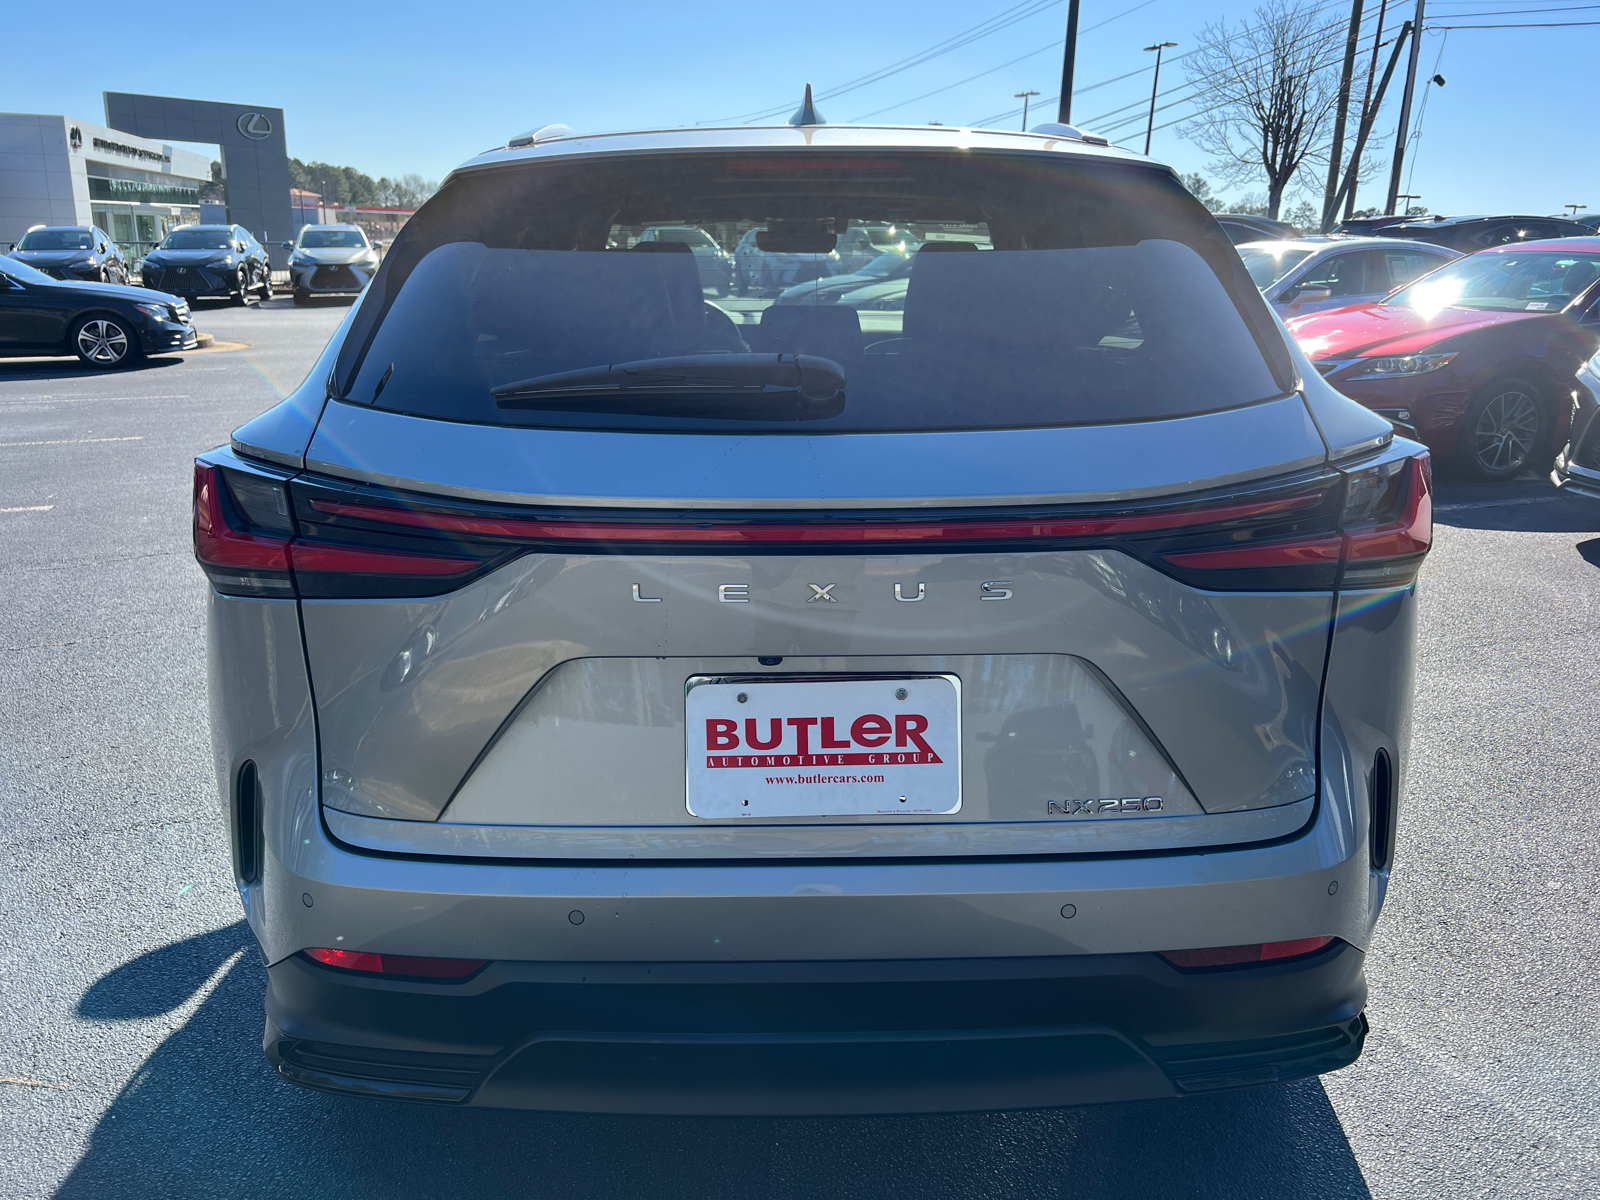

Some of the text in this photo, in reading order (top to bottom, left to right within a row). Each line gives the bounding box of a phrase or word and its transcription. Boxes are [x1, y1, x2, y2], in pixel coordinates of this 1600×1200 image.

[632, 580, 1013, 603] LEXUS
[708, 753, 934, 767] AUTOMOTIVE GROUP
[765, 773, 885, 785] www.butlercars.com
[1048, 796, 1165, 815] NX250
